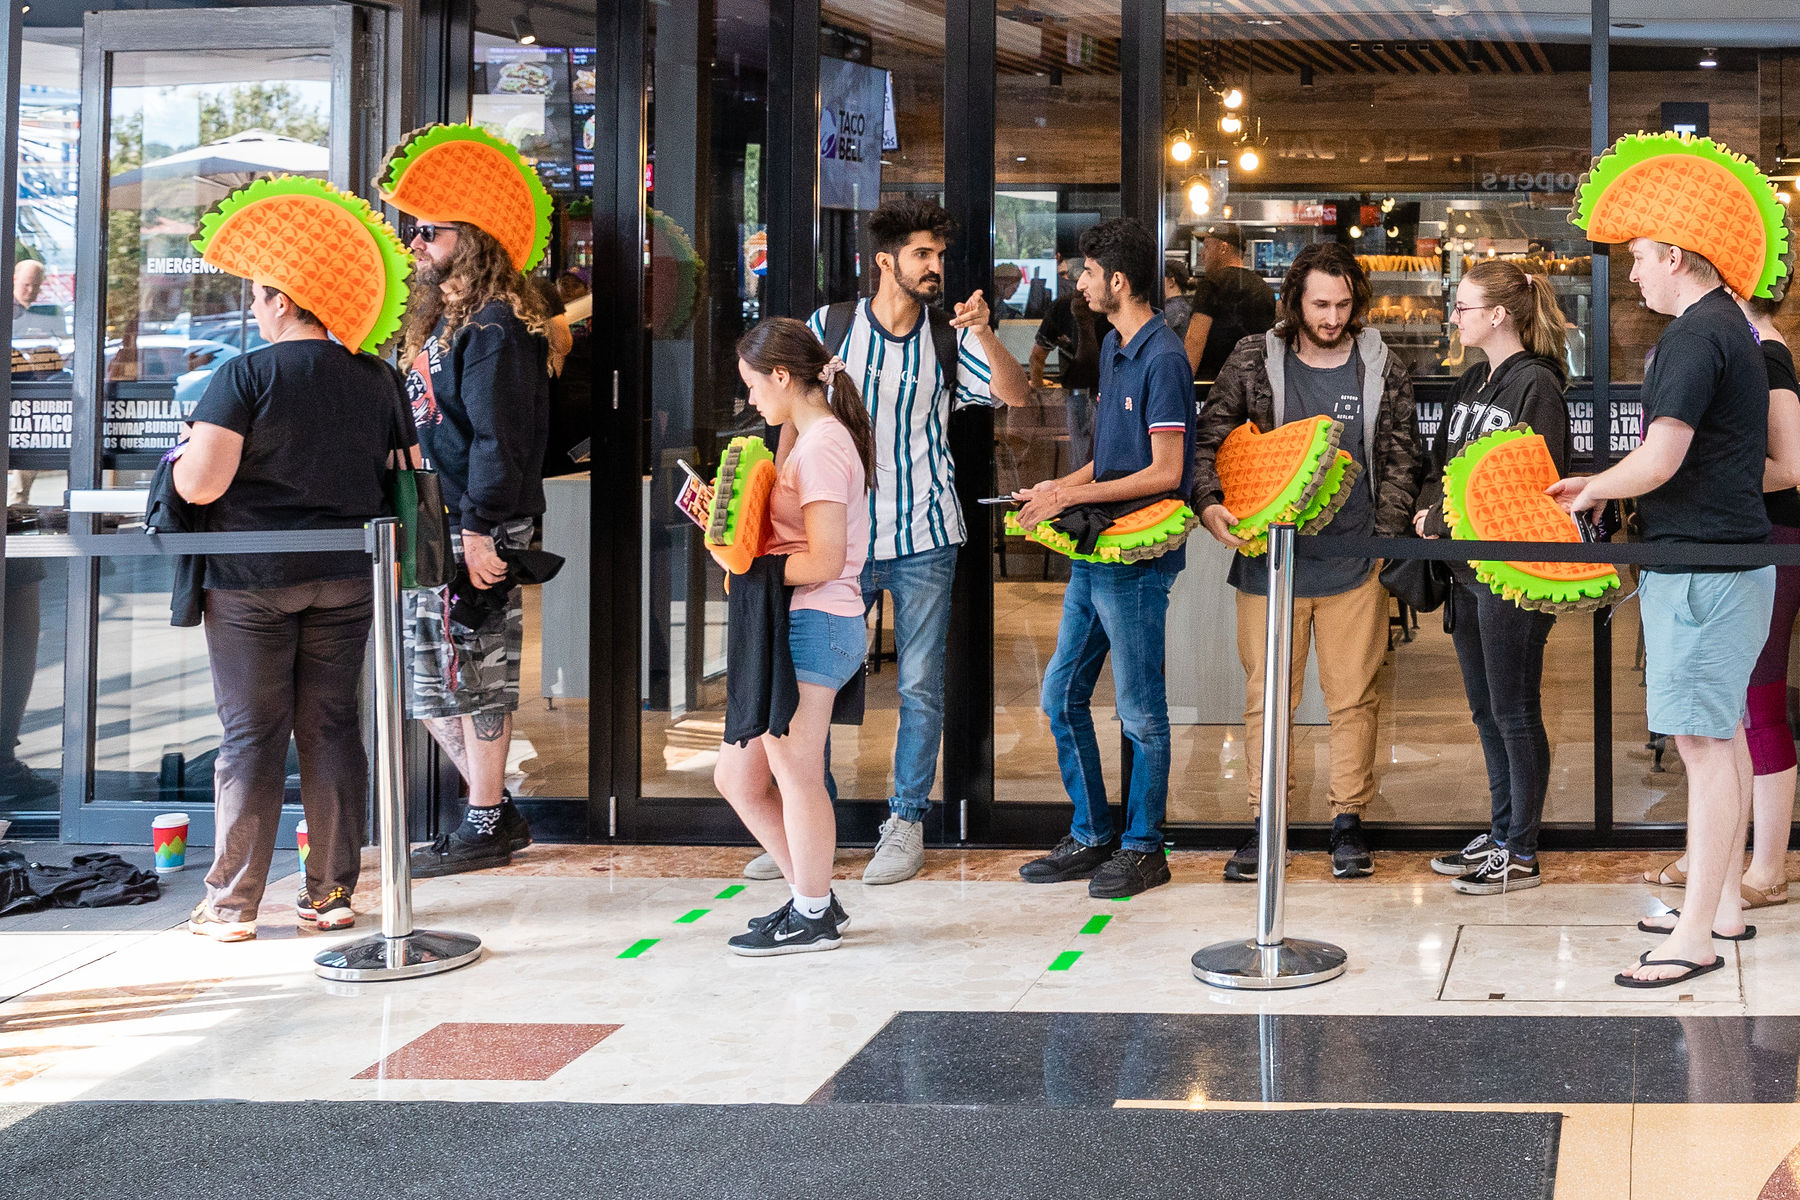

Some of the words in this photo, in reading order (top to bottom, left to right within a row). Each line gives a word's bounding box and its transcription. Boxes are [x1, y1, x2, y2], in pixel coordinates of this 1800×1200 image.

[839, 110, 865, 136] TACO
[838, 137, 863, 163] BELL
[103, 400, 182, 419] ESADILLA
[120, 437, 176, 450] QUESADILLA
